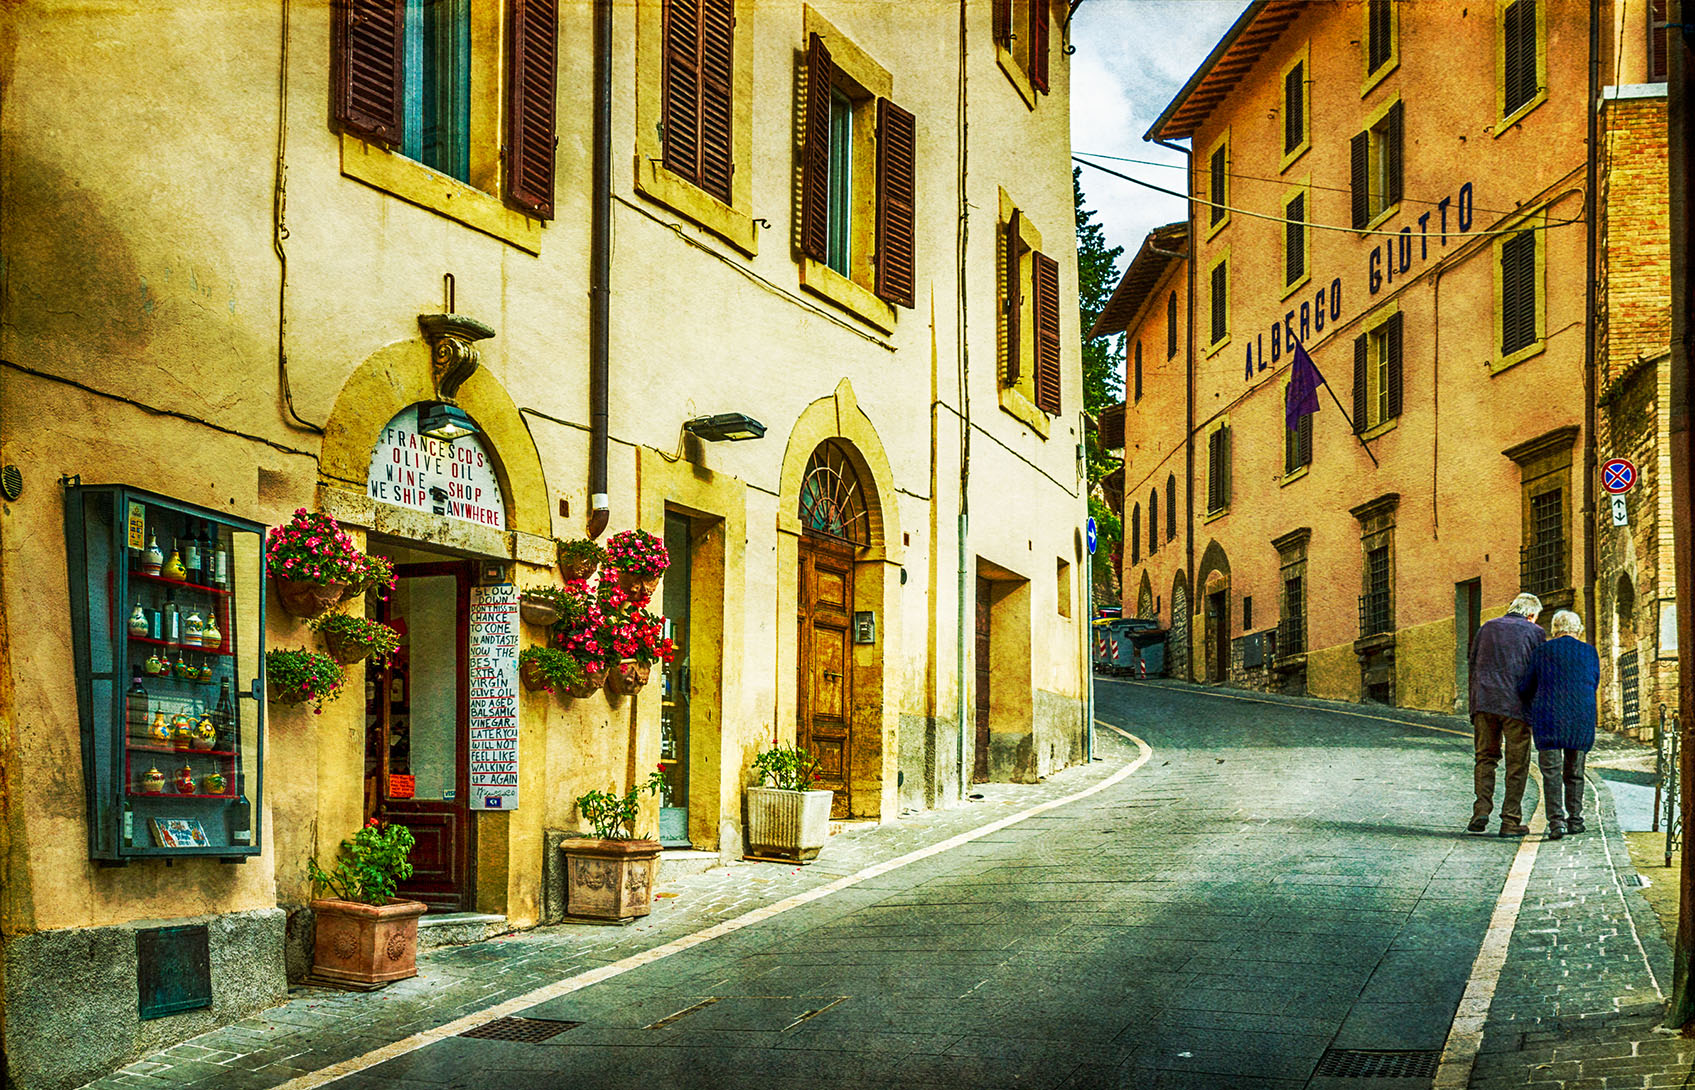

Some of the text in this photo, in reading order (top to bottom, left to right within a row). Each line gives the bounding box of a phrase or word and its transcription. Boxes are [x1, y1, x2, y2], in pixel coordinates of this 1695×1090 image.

[1245, 181, 1473, 381] ALBERGO GIOTTO
[387, 428, 484, 468] FRANCESCO'S
[392, 447, 473, 481] OLIVE OIL
[386, 464, 482, 503] WINE SHOP
[371, 480, 500, 527] WE SHIP ANYWHERE
[470, 613, 508, 622] CHANCE
[470, 623, 511, 633] TO COME
[470, 636, 479, 644] IN
[470, 647, 515, 657] NOW THE
[470, 658, 500, 668] BEST
[470, 668, 504, 678] EXTRA
[470, 679, 508, 688] VIRGIN
[470, 688, 515, 697] OLIVE OIL
[470, 698, 513, 708] AND AGED
[471, 707, 516, 717] BALSAMIC
[471, 740, 517, 749] WILL NOT
[471, 751, 516, 761] FEEL LIKE
[471, 763, 513, 772] WALKING
[472, 774, 518, 784] UP AGAIN
